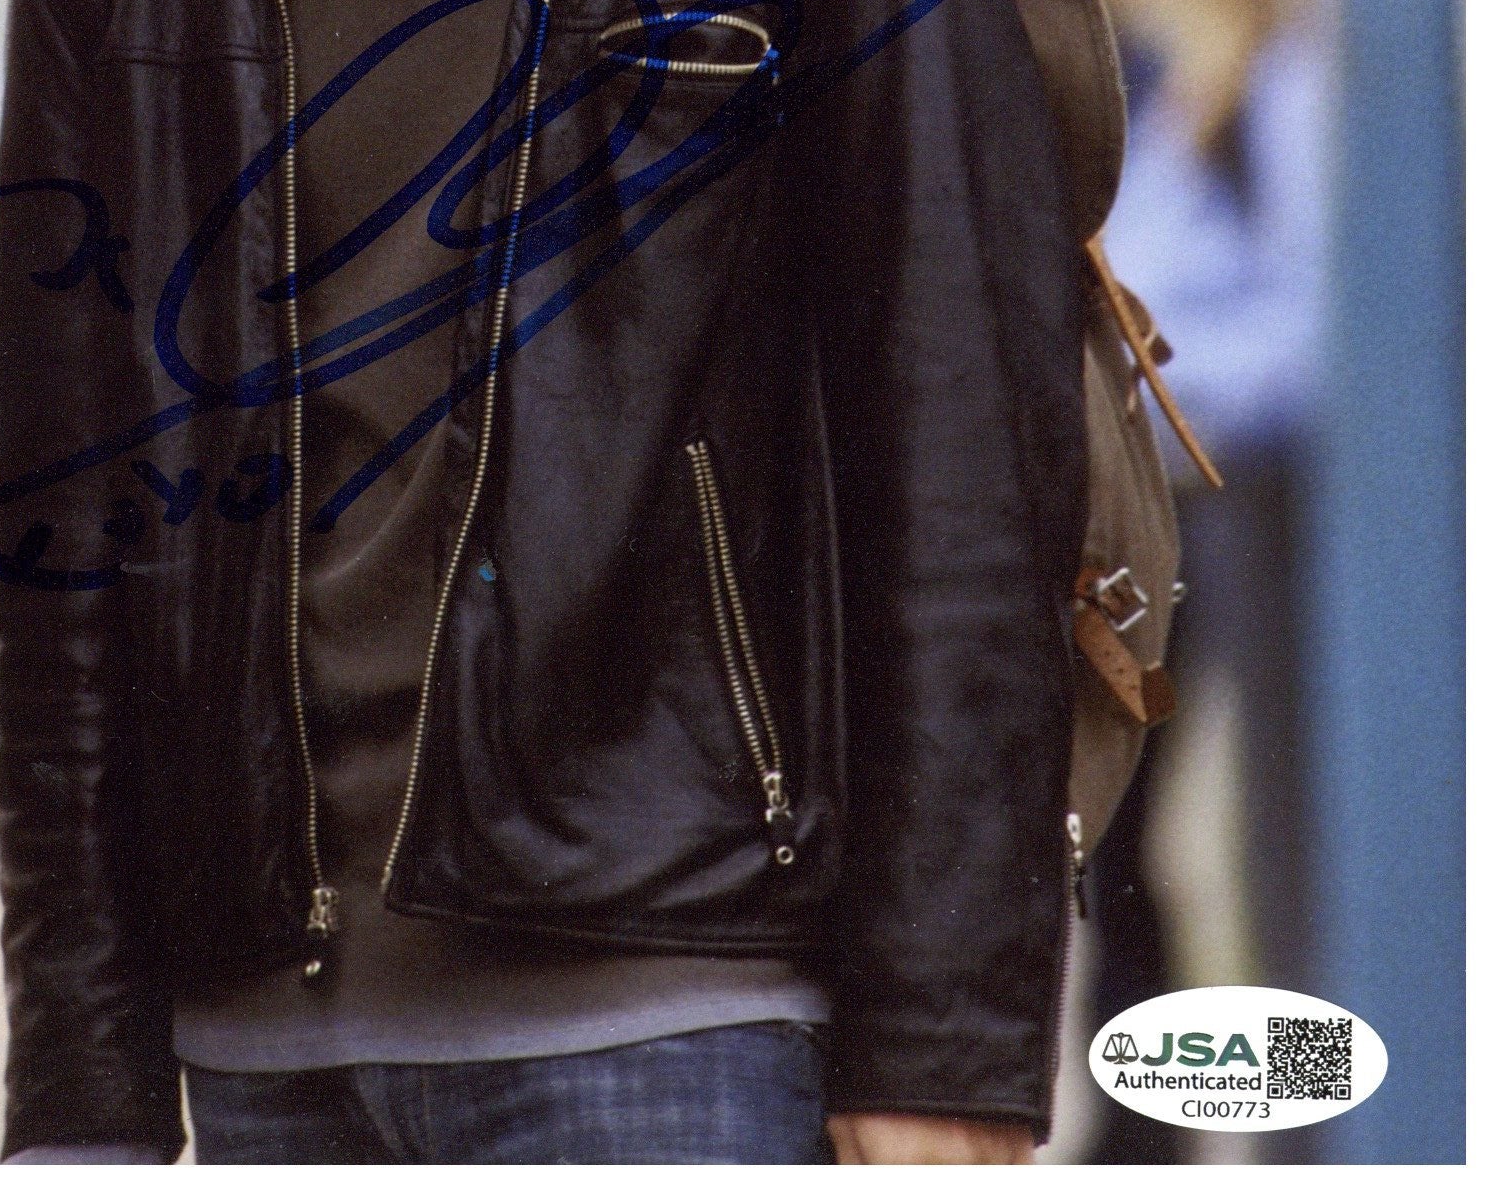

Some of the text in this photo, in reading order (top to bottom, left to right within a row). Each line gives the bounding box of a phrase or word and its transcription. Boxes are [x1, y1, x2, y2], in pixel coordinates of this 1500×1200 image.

[1140, 1032, 1260, 1067] JSA
[1114, 1071, 1262, 1091] Authenticated
[1181, 1100, 1271, 1118] CI00773
